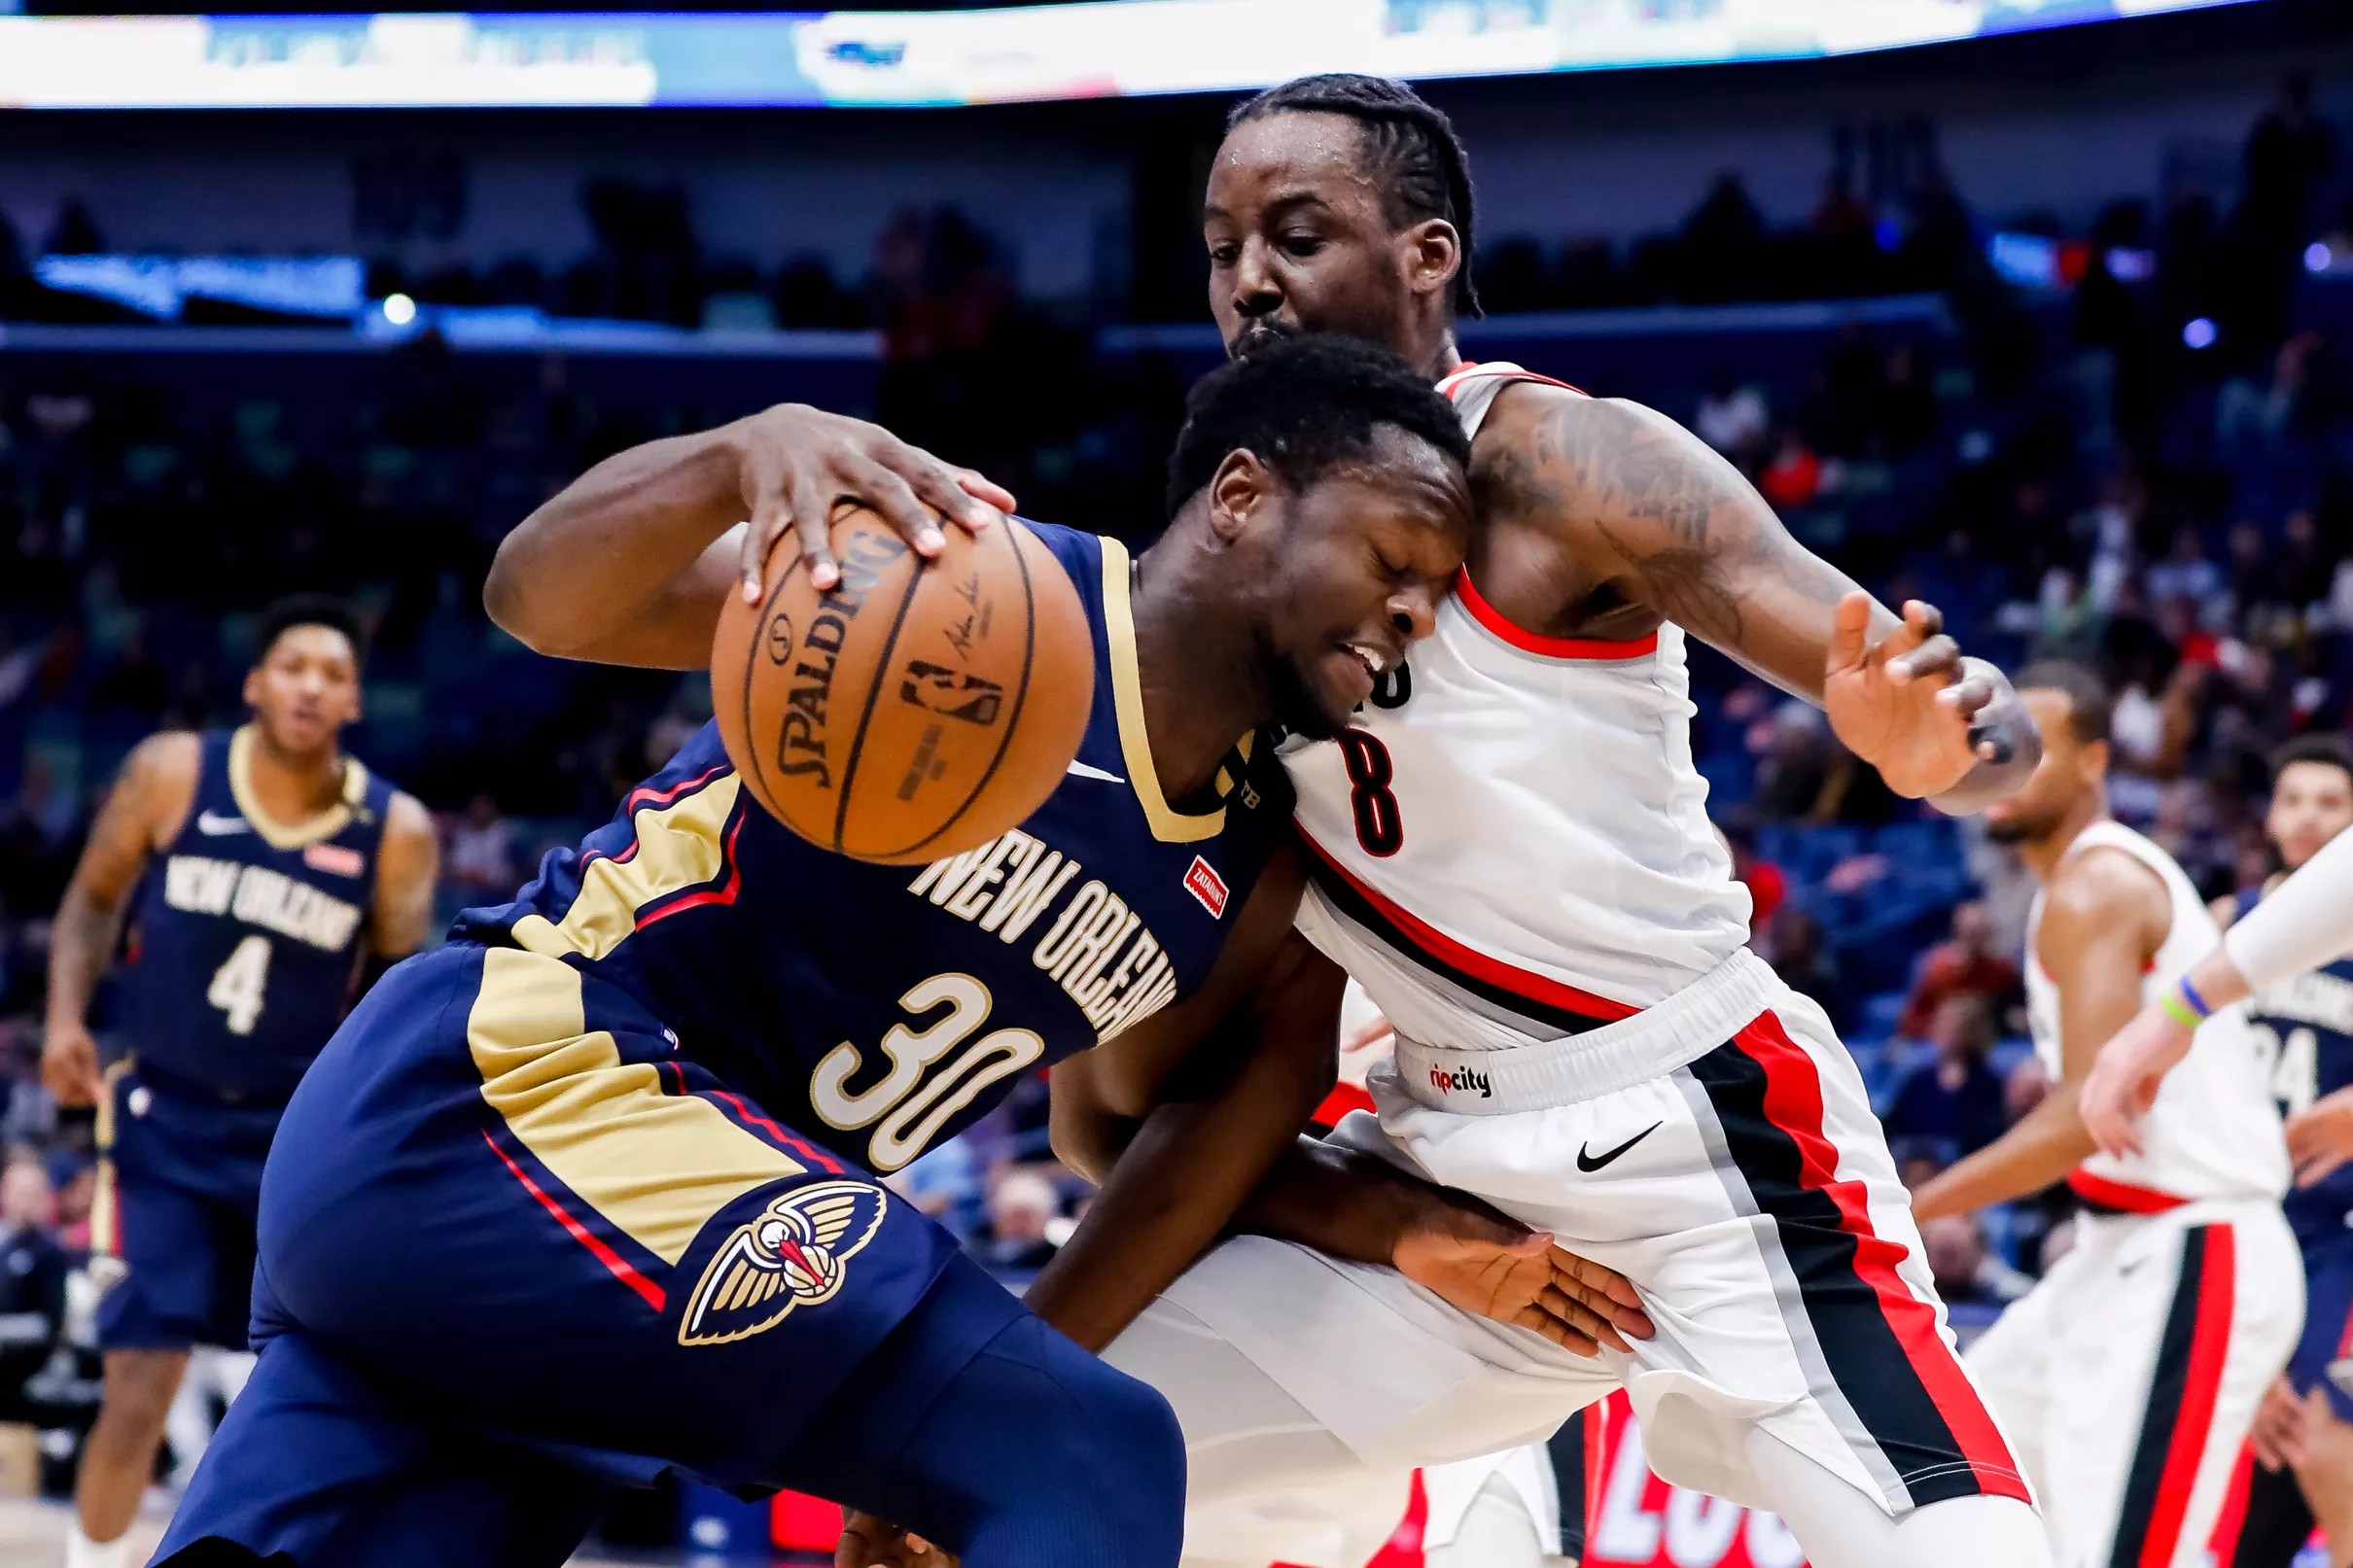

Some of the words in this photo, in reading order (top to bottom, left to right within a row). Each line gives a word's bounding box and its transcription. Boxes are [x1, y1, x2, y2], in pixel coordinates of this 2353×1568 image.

[779, 530, 910, 788] SPALDING
[1338, 727, 1403, 857] 8
[206, 935, 272, 1036] 4
[906, 827, 1082, 944] NEW
[1033, 880, 1177, 1048] ORLEAN
[809, 972, 1045, 1171] 30
[1429, 1063, 1492, 1098] ripcity
